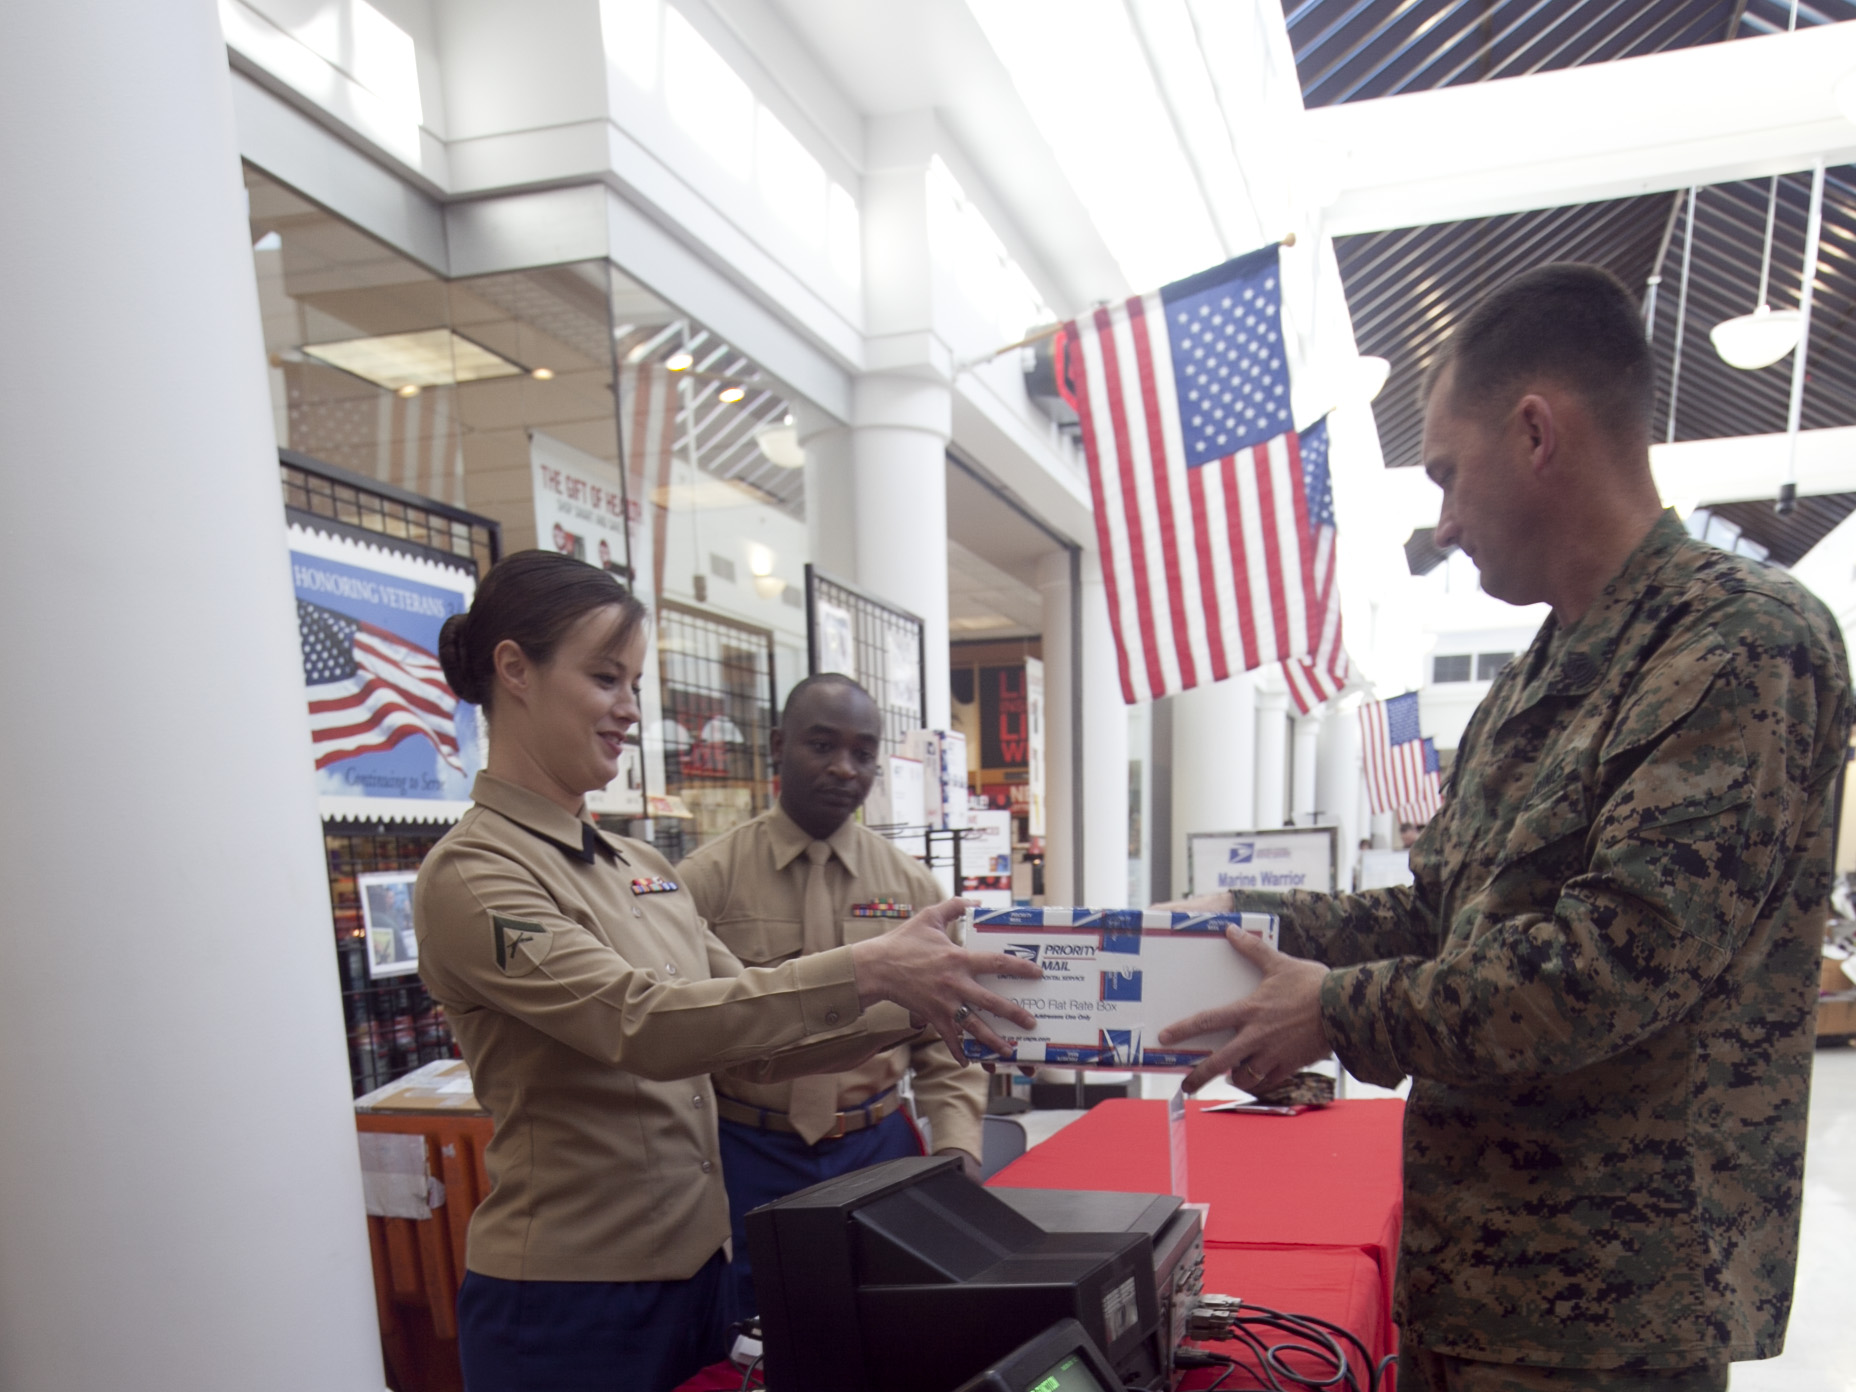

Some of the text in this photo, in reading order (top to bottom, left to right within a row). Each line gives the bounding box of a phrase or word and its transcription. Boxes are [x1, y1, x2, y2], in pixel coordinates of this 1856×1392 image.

[541, 465, 563, 495] THE
[565, 474, 587, 503] GIFT
[590, 485, 603, 509] OF
[293, 565, 446, 619] HONORING VETERANS
[345, 766, 406, 796] Continuing
[1218, 871, 1306, 888] Marine Warrior
[1044, 944, 1098, 956] PRIORITY
[1041, 961, 1071, 971] MAIL
[1048, 999, 1067, 1010] Flat
[1069, 1000, 1094, 1011] Rate
[1096, 1001, 1118, 1012] Box
[1078, 1014, 1092, 1022] Only
